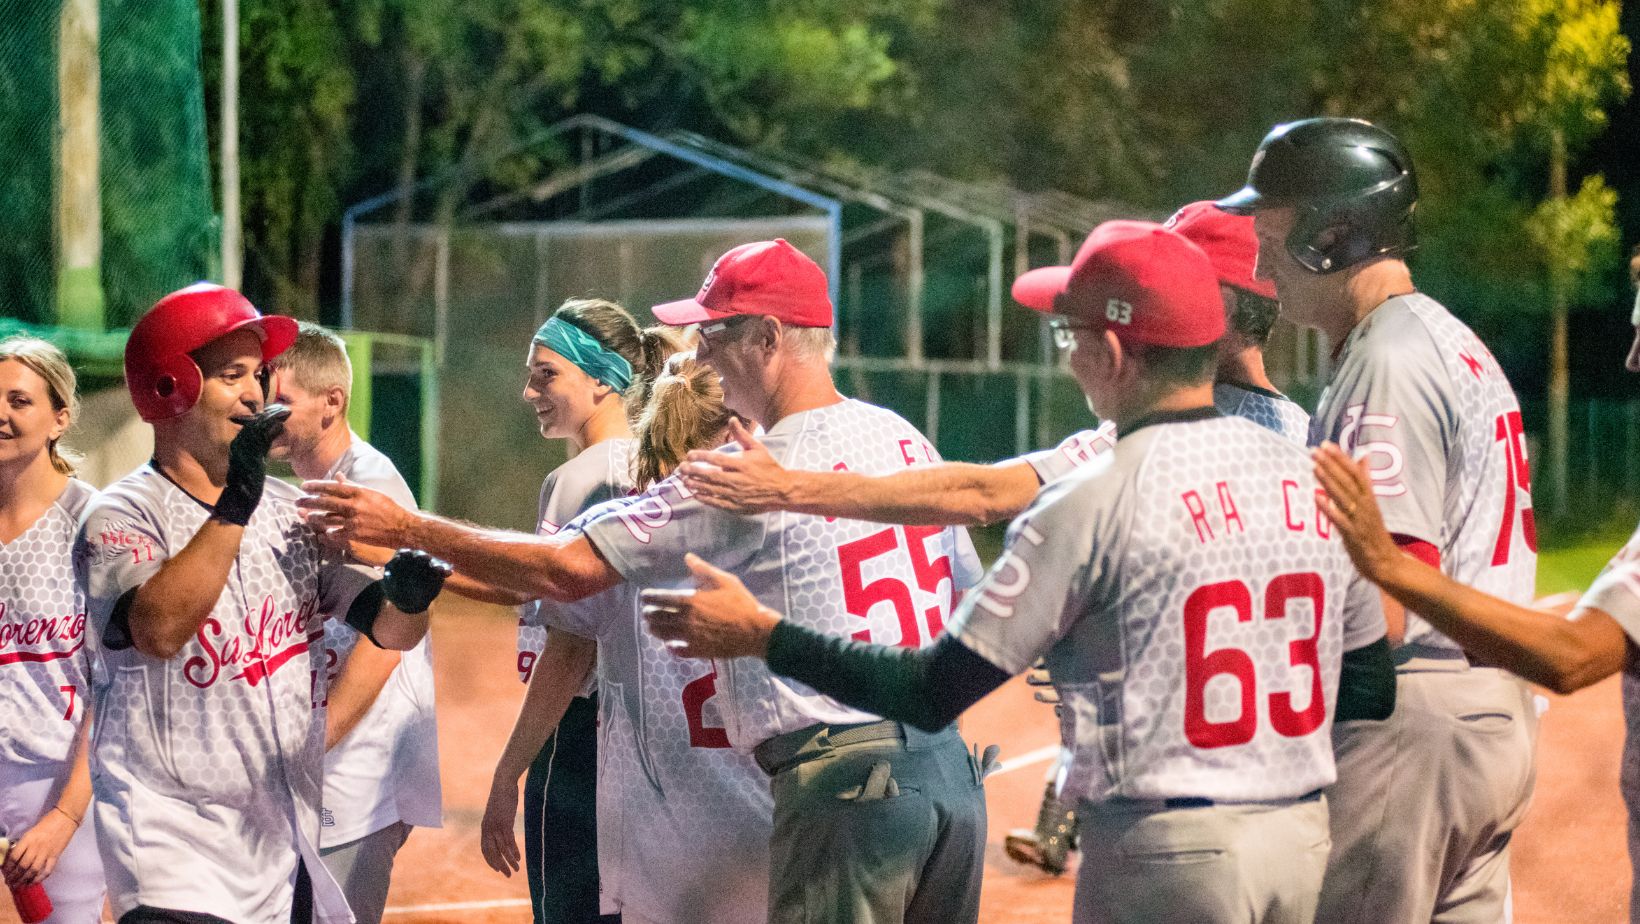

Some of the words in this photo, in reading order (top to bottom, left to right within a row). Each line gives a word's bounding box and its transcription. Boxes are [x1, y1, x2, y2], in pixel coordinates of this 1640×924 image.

[1106, 298, 1132, 324] 63
[132, 542, 155, 565] 11
[837, 524, 957, 650] 55
[1183, 572, 1326, 750] 63
[60, 686, 76, 720] 7
